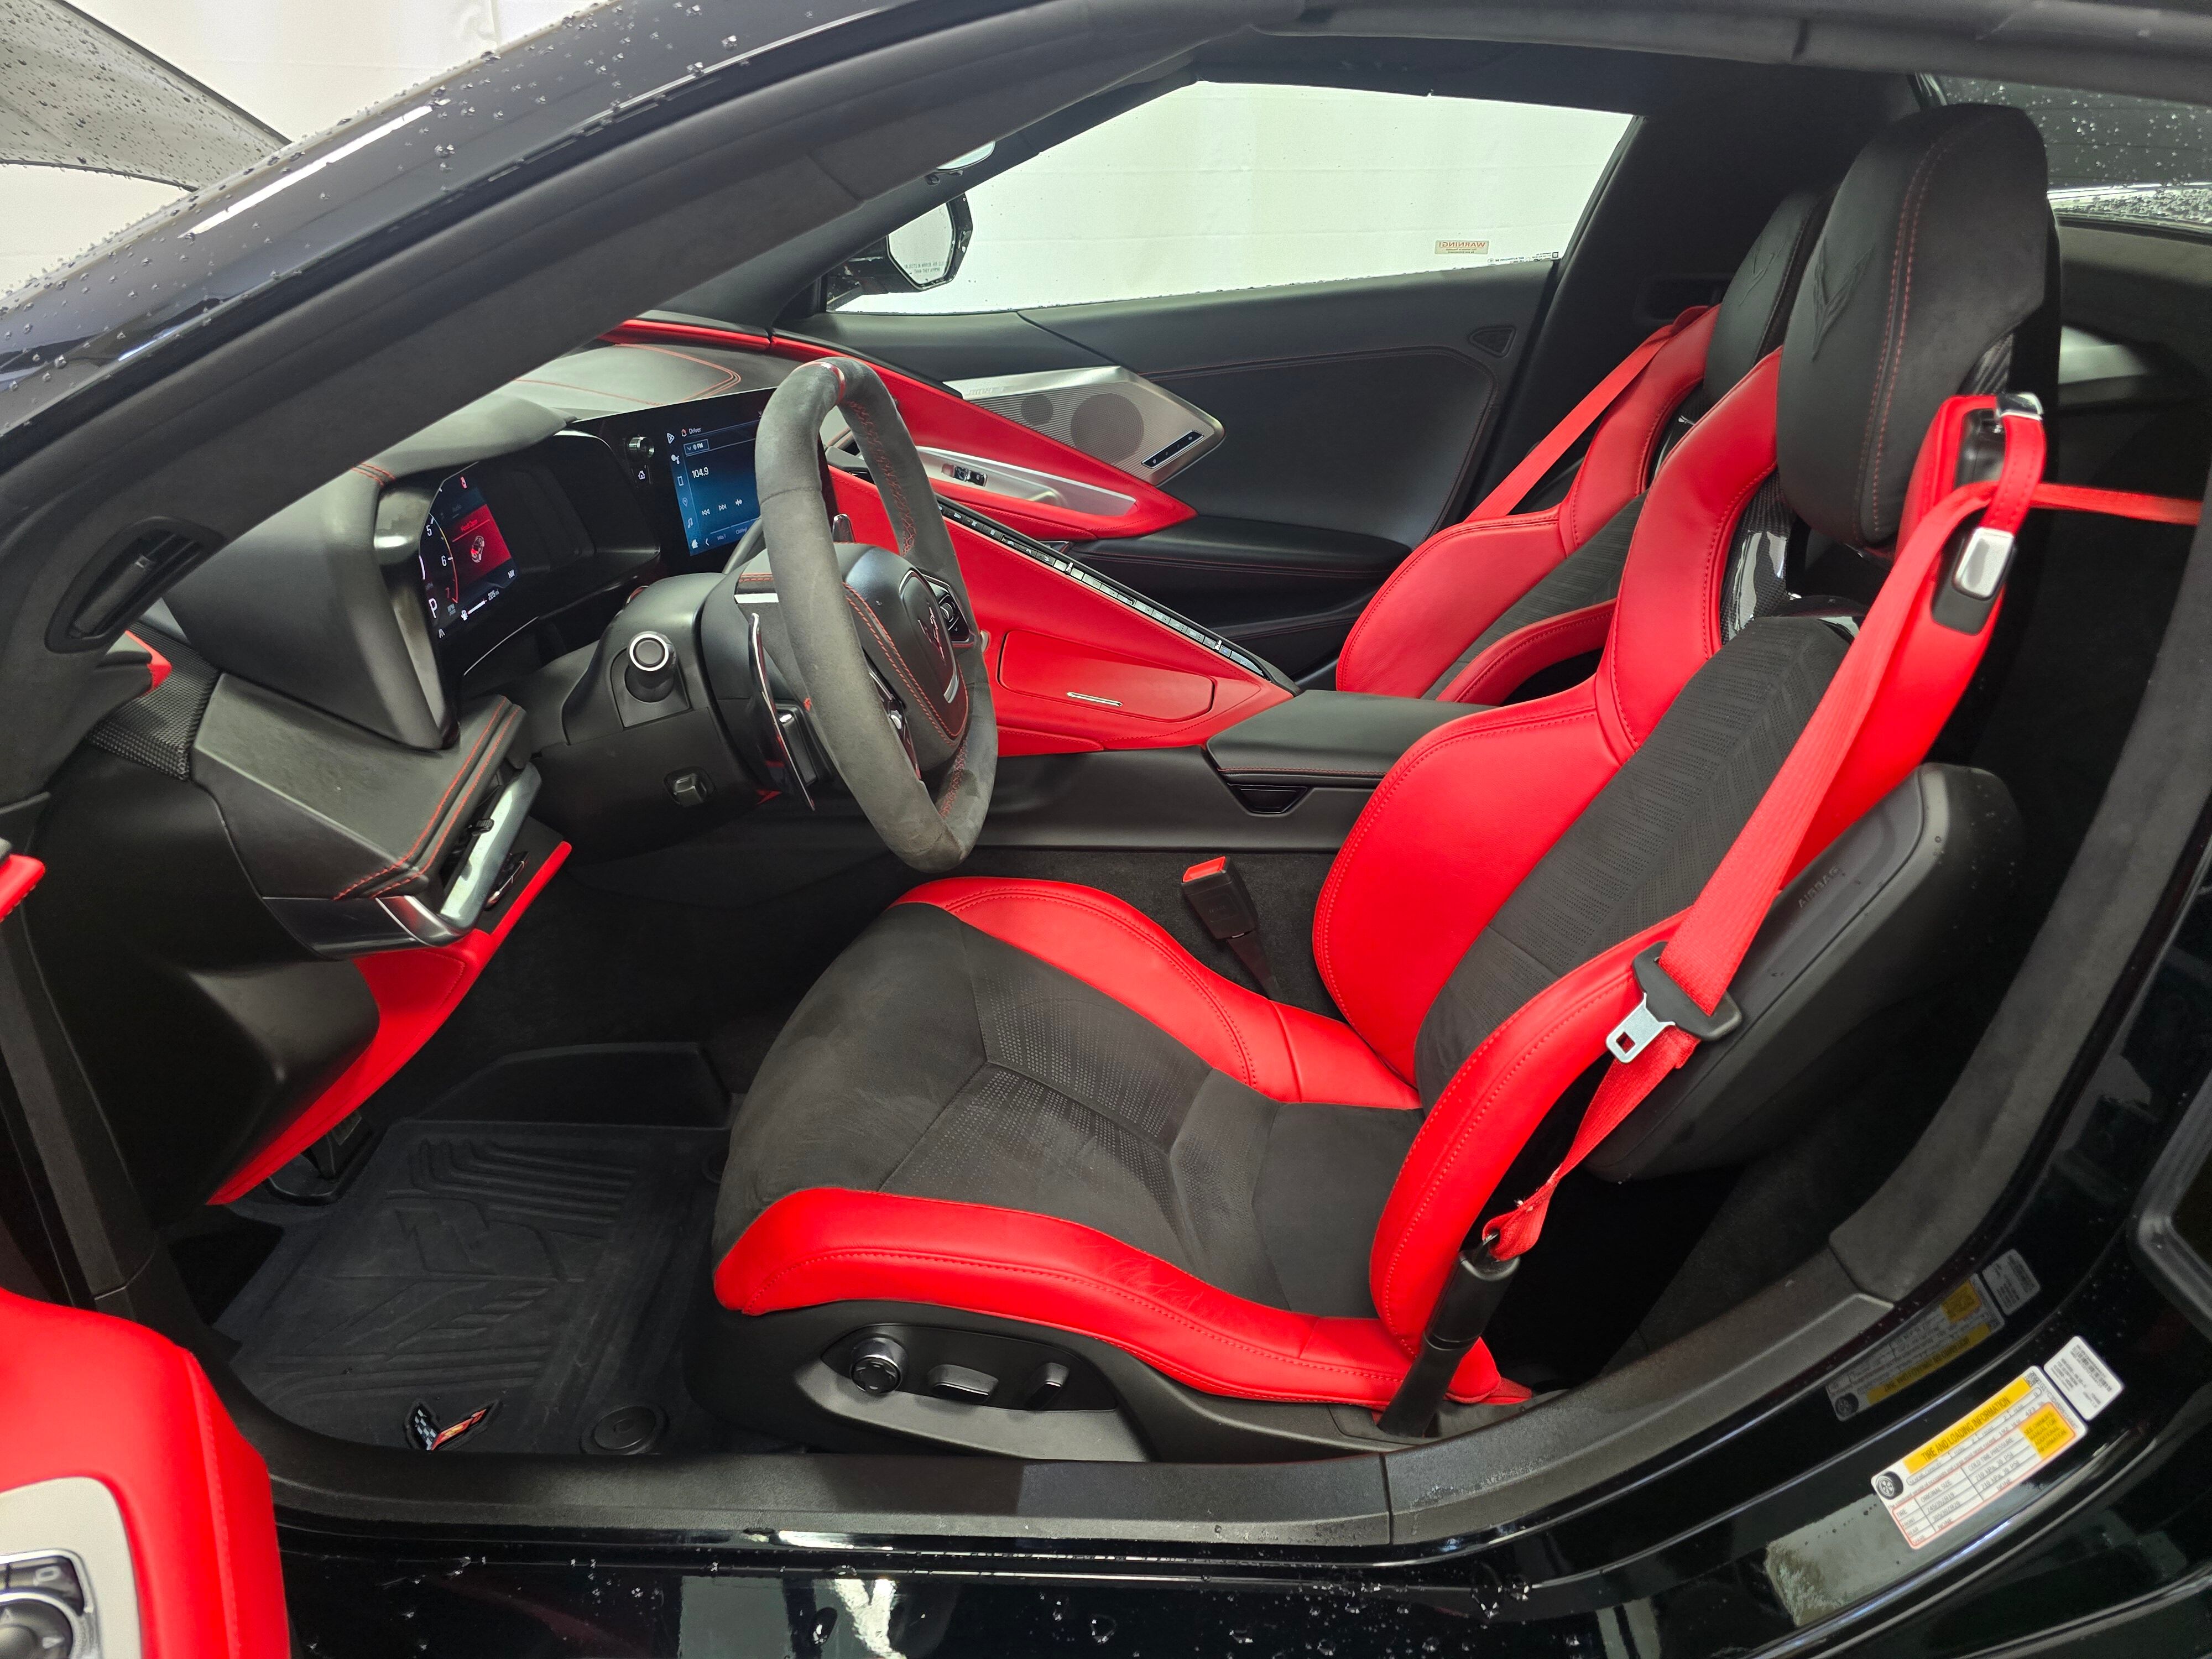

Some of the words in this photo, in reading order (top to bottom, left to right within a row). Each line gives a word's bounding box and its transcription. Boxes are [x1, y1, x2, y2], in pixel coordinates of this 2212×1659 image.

[691, 467, 709, 478] 104.9
[426, 525, 432, 536] 5
[441, 555, 447, 567] 6
[508, 569, 515, 579] NW
[428, 598, 437, 619] P
[1999, 1427, 2008, 1436] 192
[2024, 1406, 2036, 1416] 423
[1921, 1447, 1937, 1462] TIRE
[1934, 1439, 1948, 1452] AND
[1946, 1422, 1973, 1444] LOADING
[1971, 1396, 2010, 1426] INFORMATION
[1967, 1459, 1981, 1470] COLD
[1990, 1437, 2013, 1455] PRESSURE
[1996, 1477, 2012, 1490] NONE
[1920, 1486, 1940, 1503] ORIGINAL
[1897, 1508, 1906, 1517] TIRE
[1937, 1517, 1953, 1530] NONE
